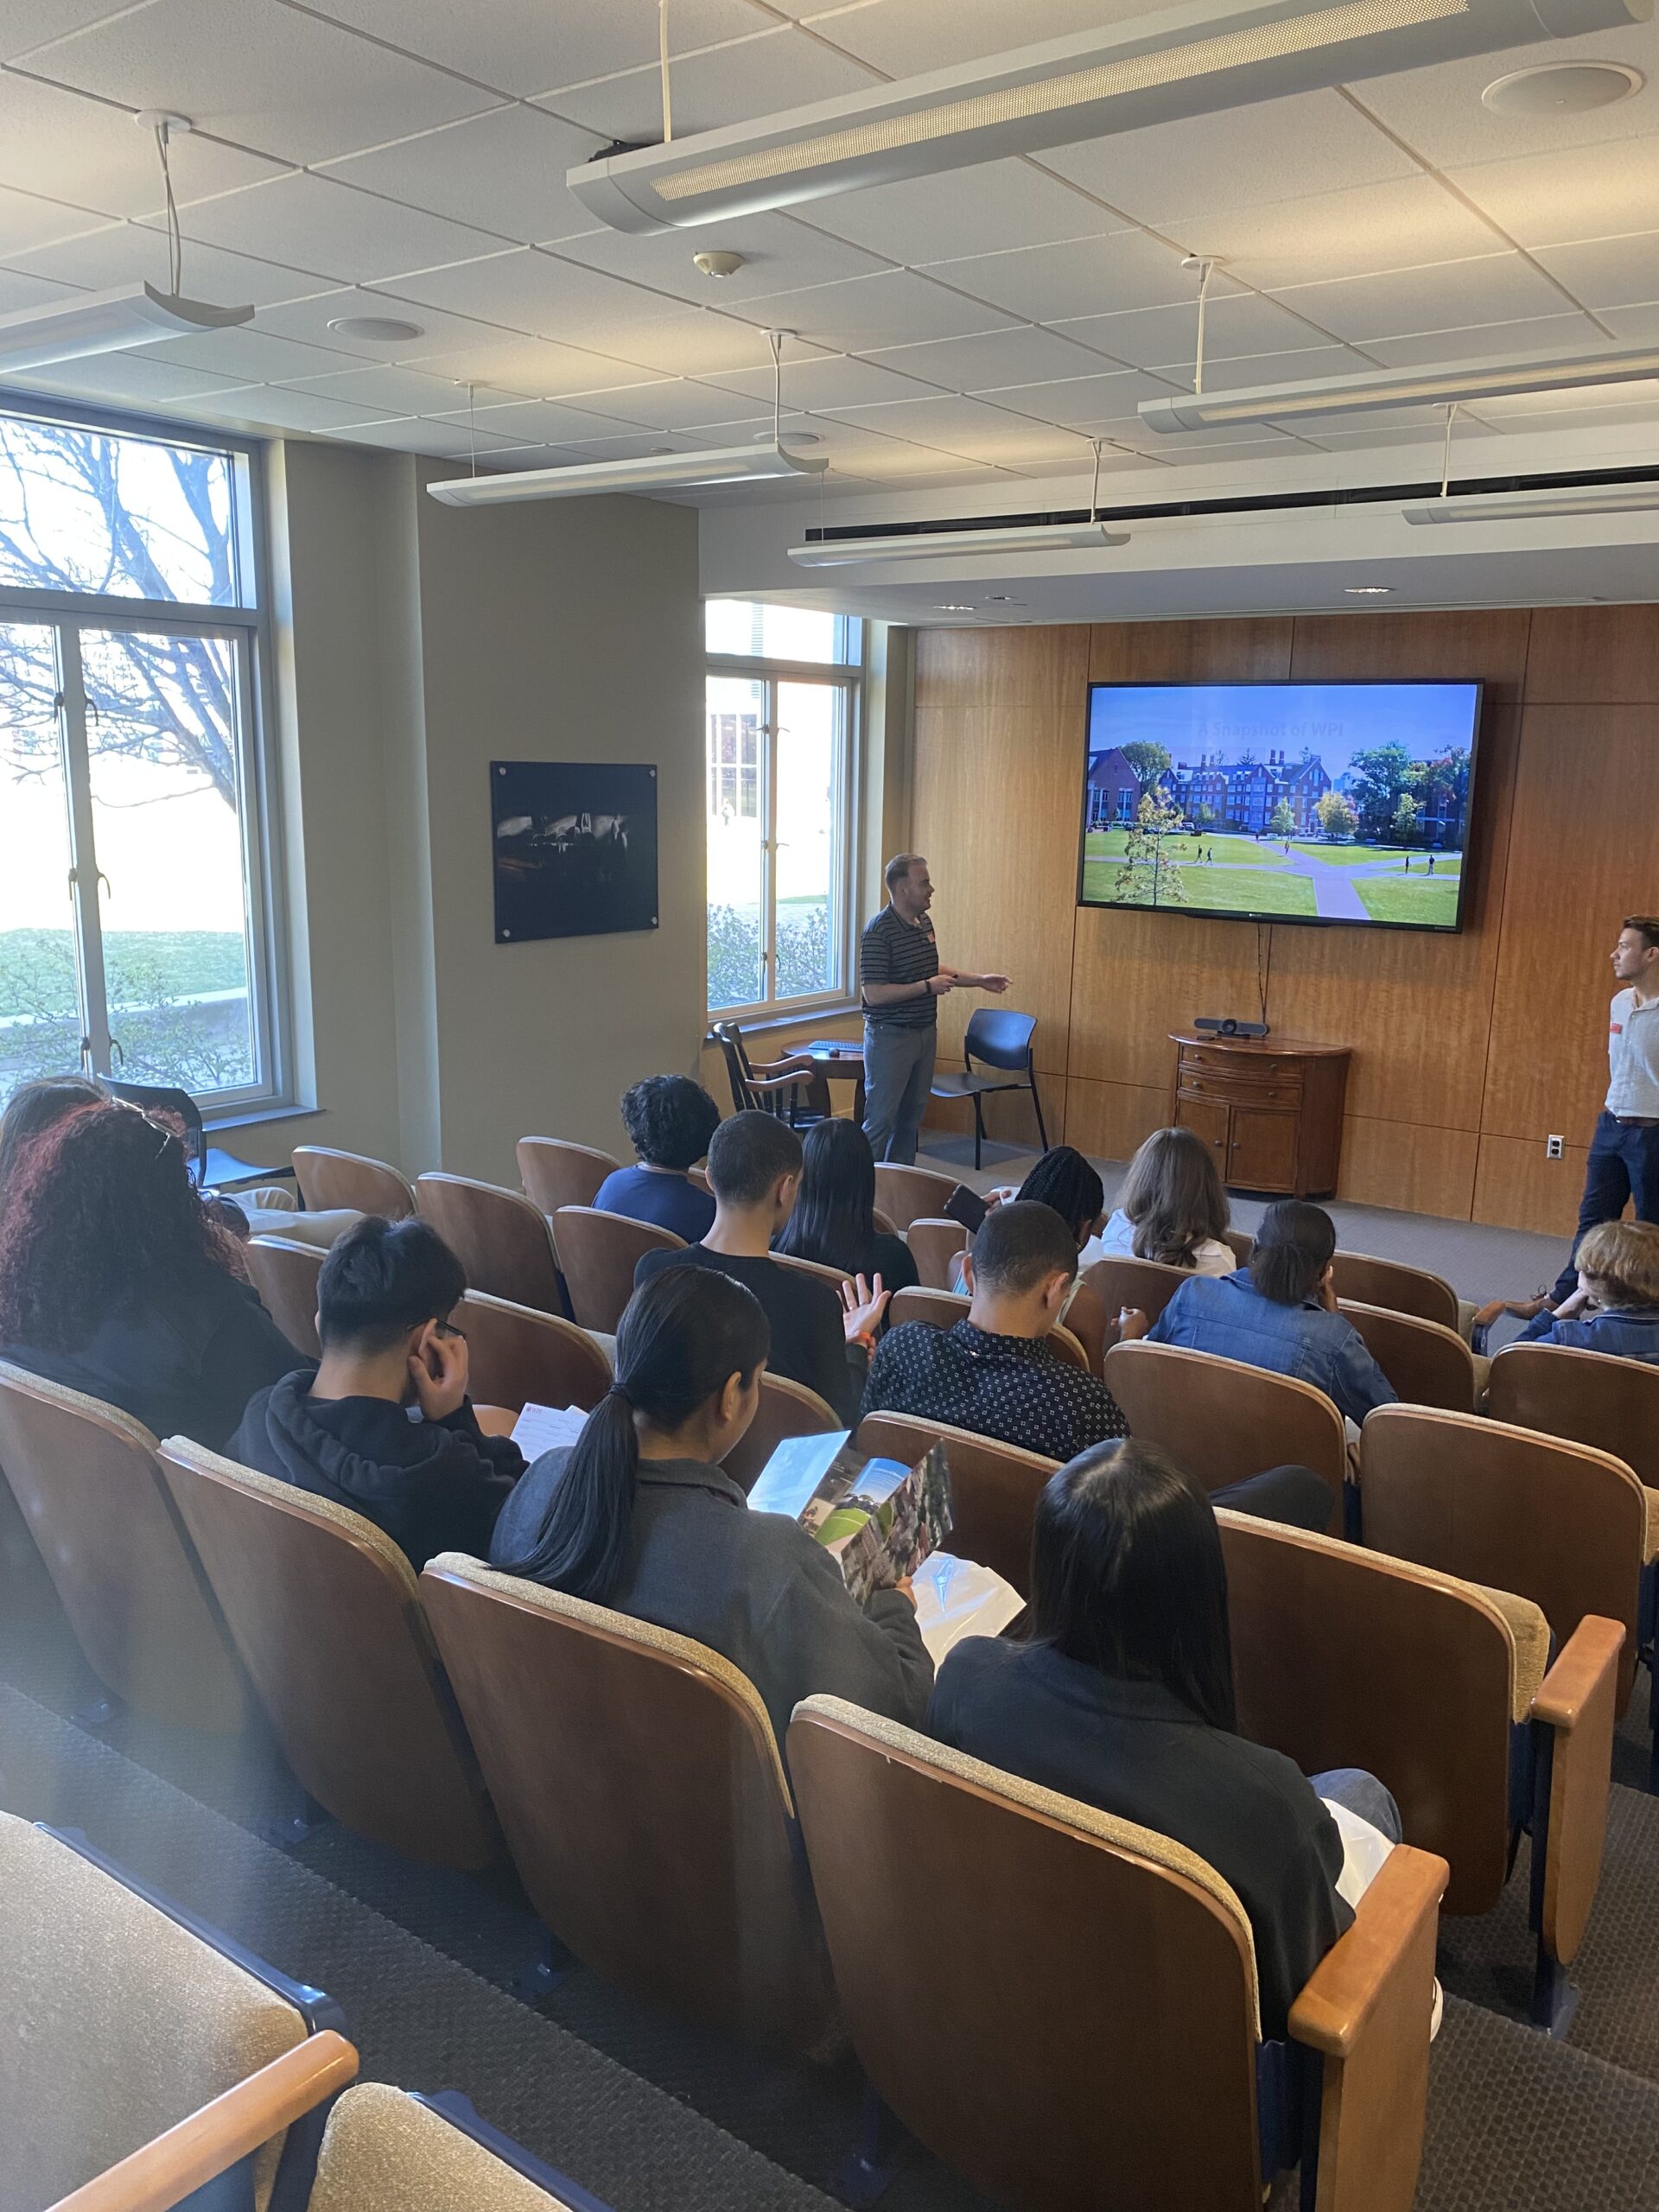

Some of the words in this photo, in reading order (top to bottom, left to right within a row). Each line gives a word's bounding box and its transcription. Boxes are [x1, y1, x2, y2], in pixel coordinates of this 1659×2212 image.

[1198, 721, 1208, 736] A
[1213, 721, 1287, 740] Snapshot
[1292, 721, 1309, 736] of
[1313, 721, 1343, 736] WPI
